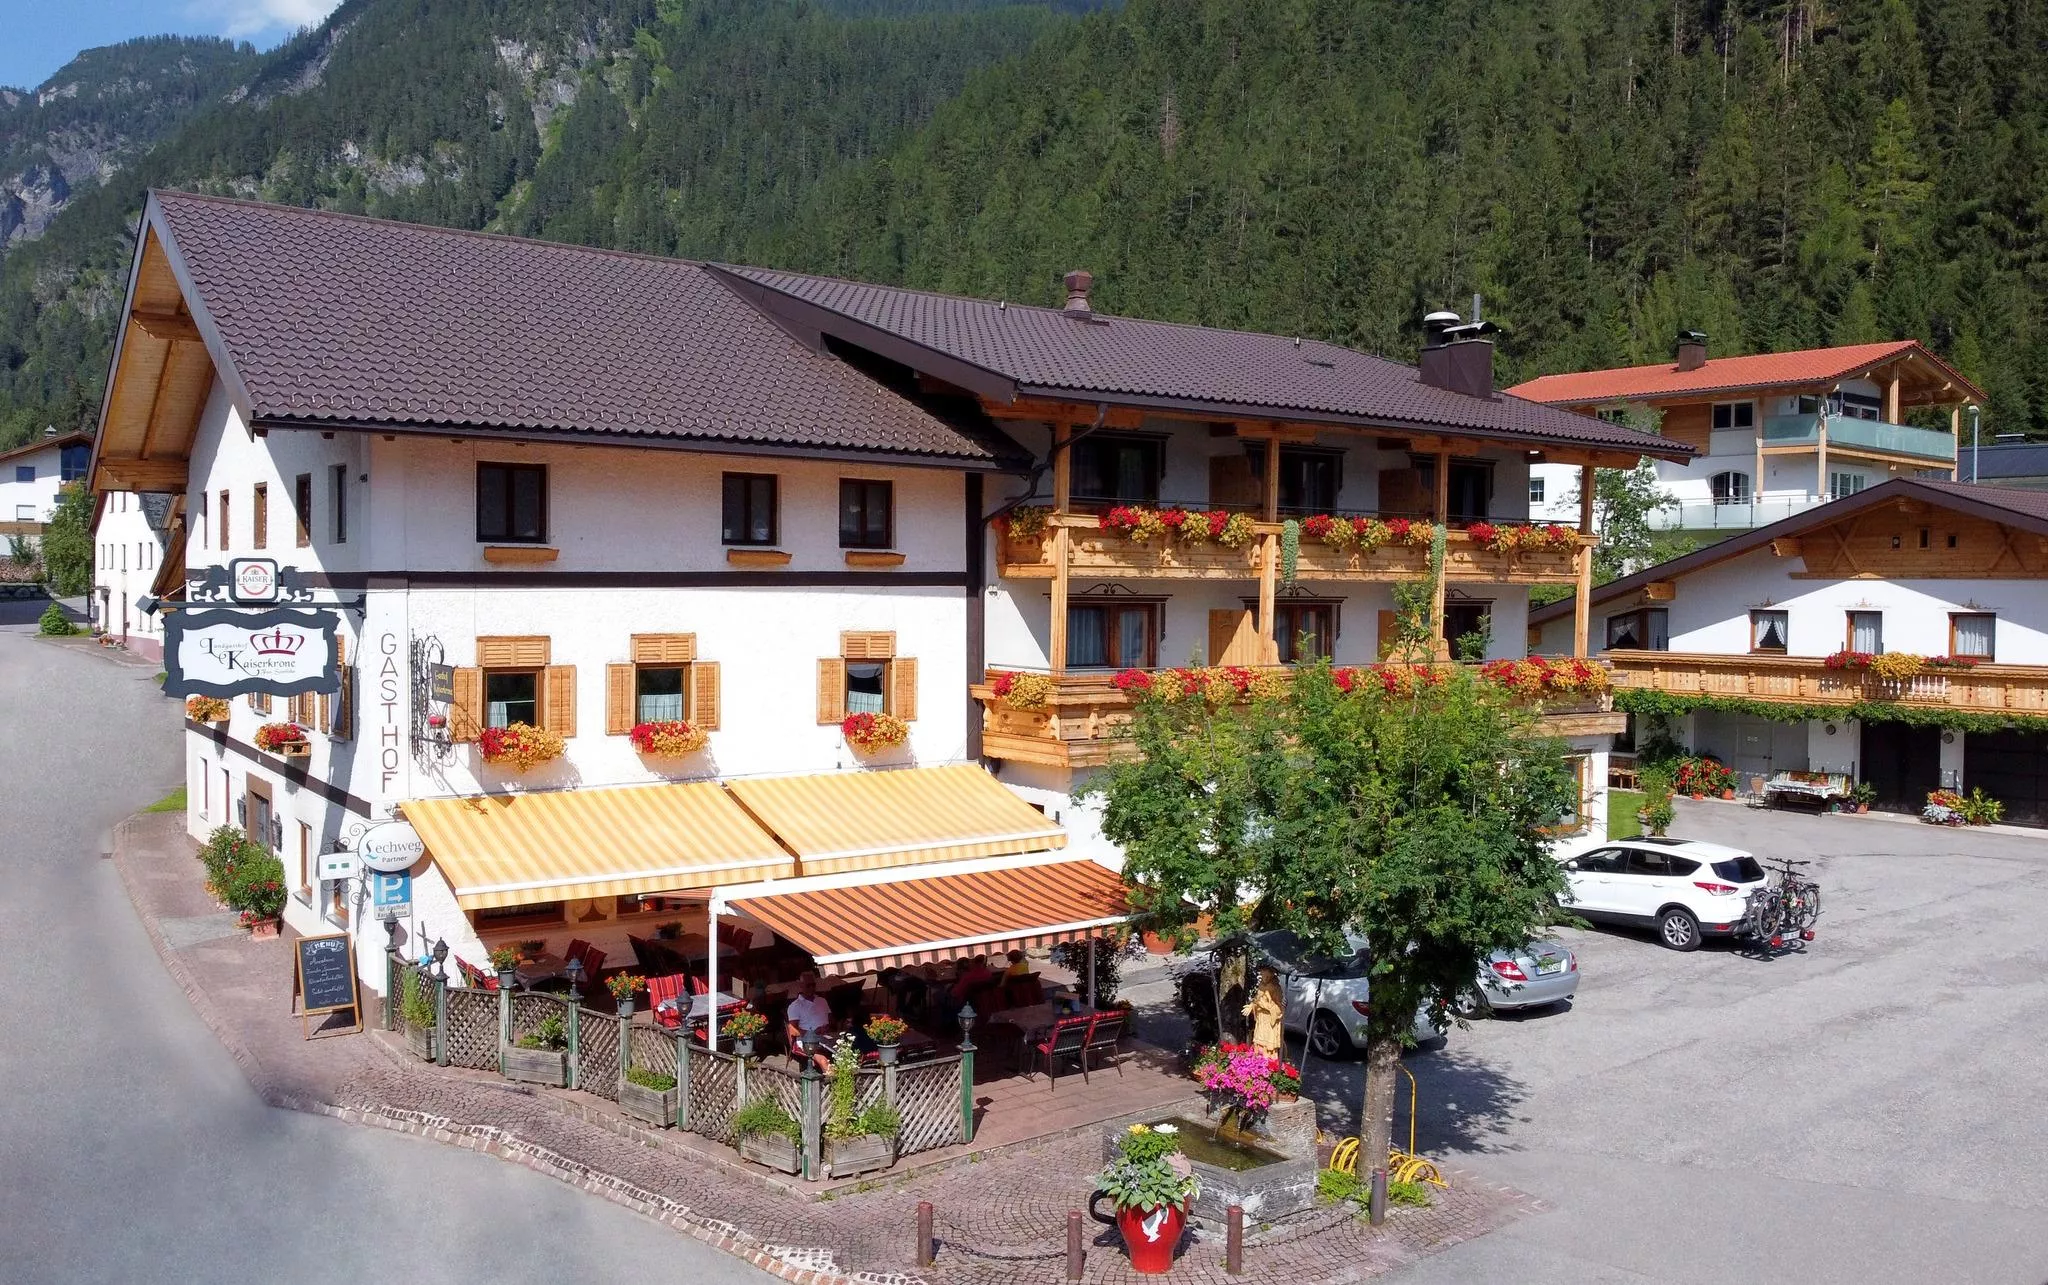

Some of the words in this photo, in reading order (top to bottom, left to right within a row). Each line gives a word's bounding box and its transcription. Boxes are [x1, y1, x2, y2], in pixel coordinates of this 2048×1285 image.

[242, 575, 269, 583] KAISER
[219, 650, 296, 677] Kaiserkrone
[380, 633, 399, 794] GASTHOF
[365, 840, 422, 860] Lechweg
